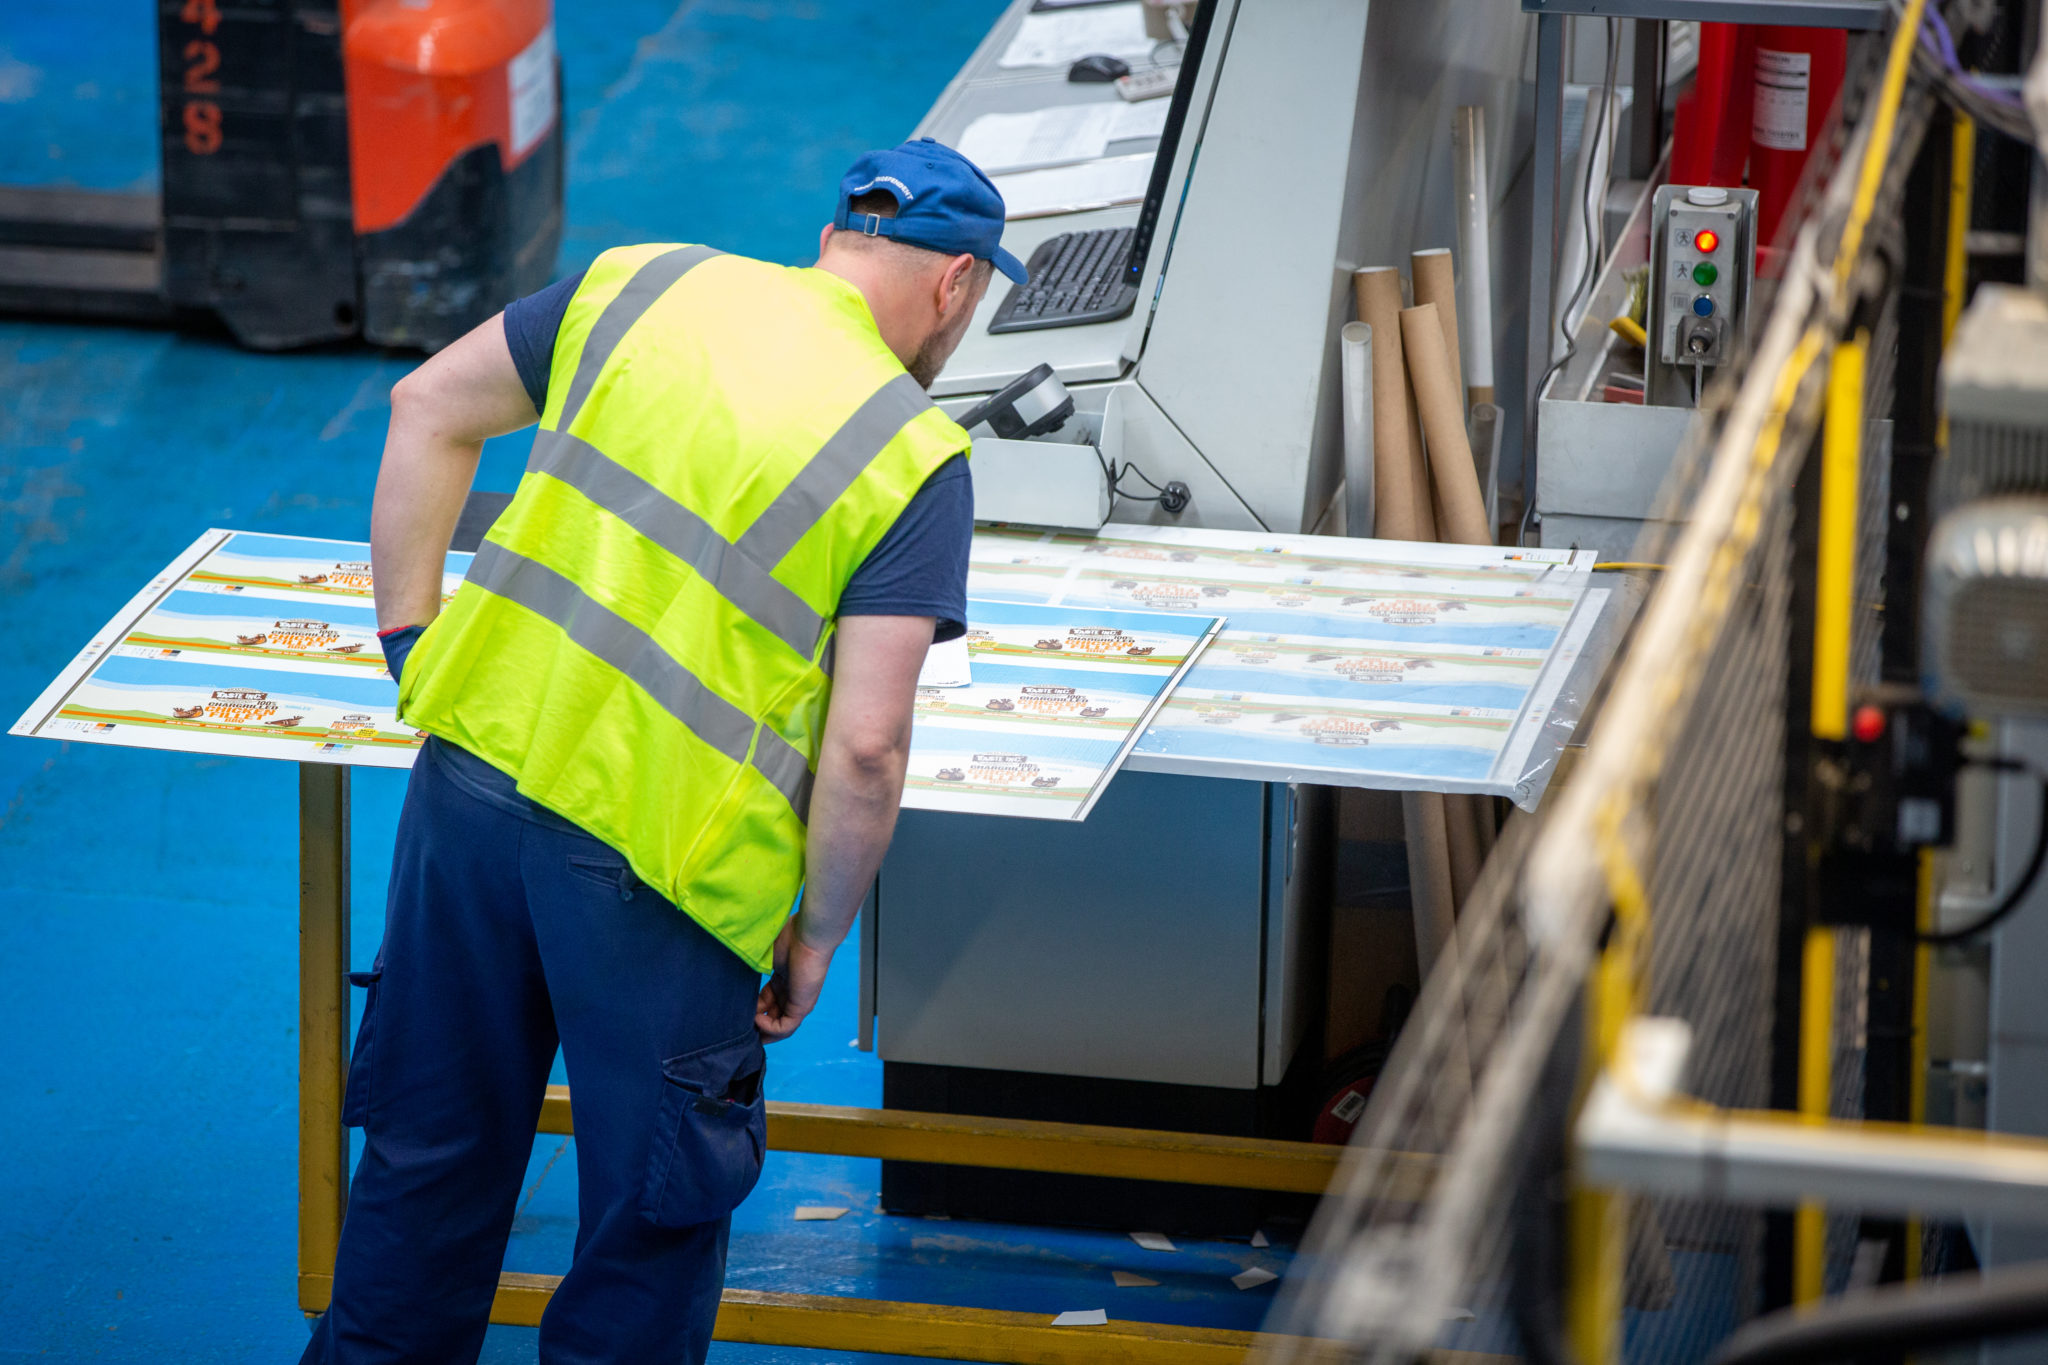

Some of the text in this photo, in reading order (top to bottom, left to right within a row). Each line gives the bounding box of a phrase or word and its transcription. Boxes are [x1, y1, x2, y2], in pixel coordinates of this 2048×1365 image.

[216, 691, 243, 700] TASTE
[208, 701, 279, 710] CHARGRILLED
[204, 706, 276, 716] CHICKEN
[209, 712, 265, 721] FILLET
